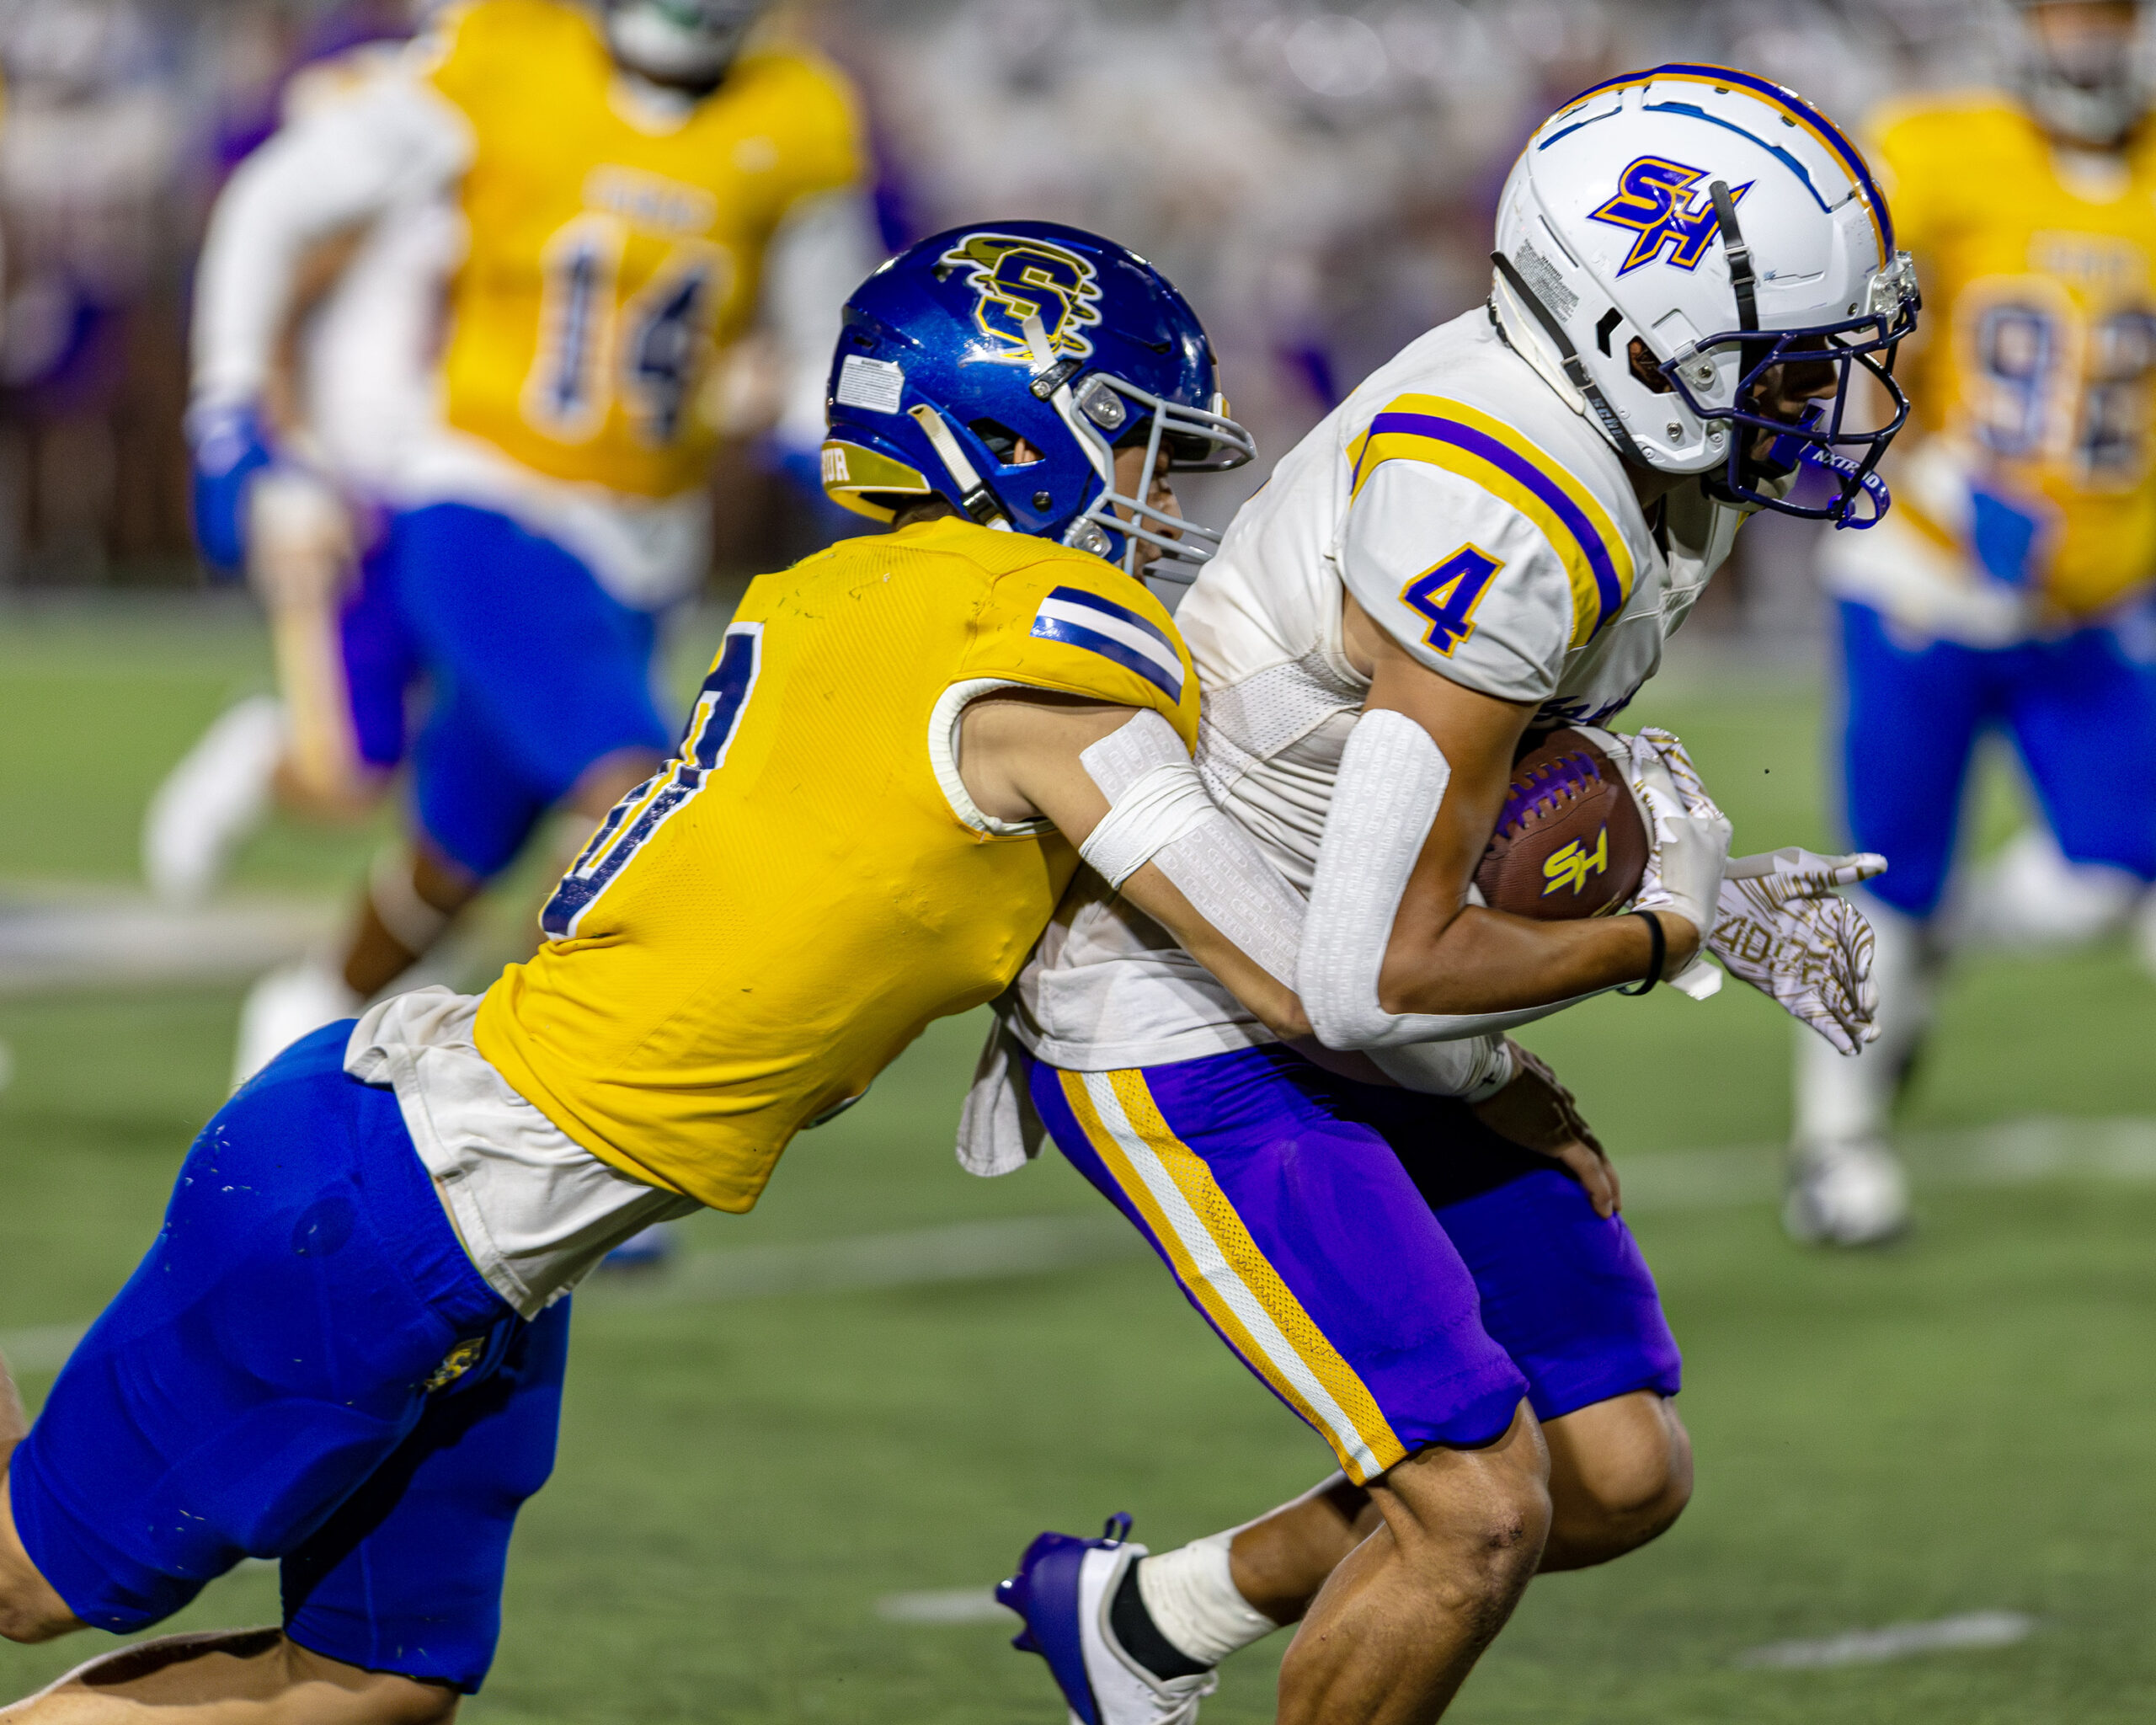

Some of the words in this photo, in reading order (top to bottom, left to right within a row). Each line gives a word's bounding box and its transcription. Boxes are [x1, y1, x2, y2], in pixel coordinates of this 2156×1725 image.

[1587, 155, 1757, 278] SH
[1400, 543, 1505, 657] 4
[1540, 819, 1608, 899] SH
